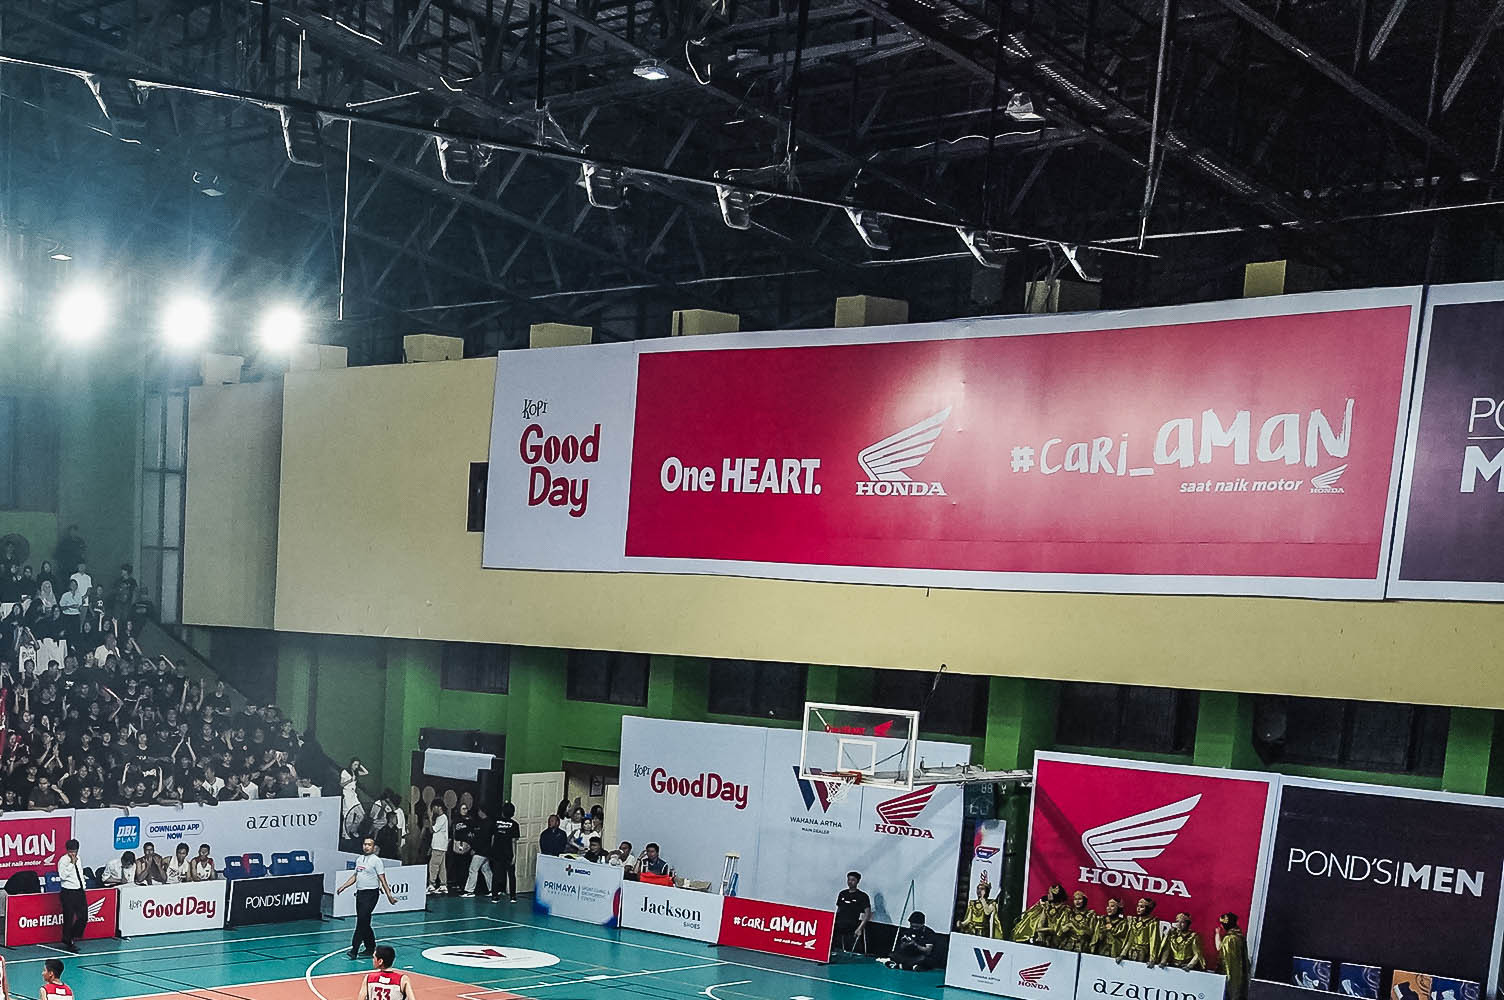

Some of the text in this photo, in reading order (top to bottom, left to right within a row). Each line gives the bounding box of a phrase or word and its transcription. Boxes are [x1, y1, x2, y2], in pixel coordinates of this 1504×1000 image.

[519, 423, 601, 464] Good
[660, 457, 716, 492] One
[527, 466, 589, 518] Day
[856, 481, 947, 496] HONDA
[1179, 478, 1303, 493] saat naik motor
[650, 768, 704, 797] Good
[707, 773, 748, 809] Day
[149, 823, 200, 833] DOWNLOAD APP
[790, 816, 842, 828] WAHANA ARTHA
[117, 825, 138, 836] DBL
[166, 832, 183, 840] NOW
[874, 824, 934, 839] HONDA
[116, 836, 138, 844] PLAY
[1289, 848, 1484, 897] POND'S MEN
[544, 880, 576, 894] PRIMAYA
[1079, 867, 1191, 898] HONDA
[142, 897, 184, 918] Good
[185, 896, 216, 918] Day
[245, 891, 310, 908] POND'S MEN
[641, 896, 701, 921] Jackson
[19, 914, 65, 928] One HEAR
[1018, 981, 1049, 990] HONDA
